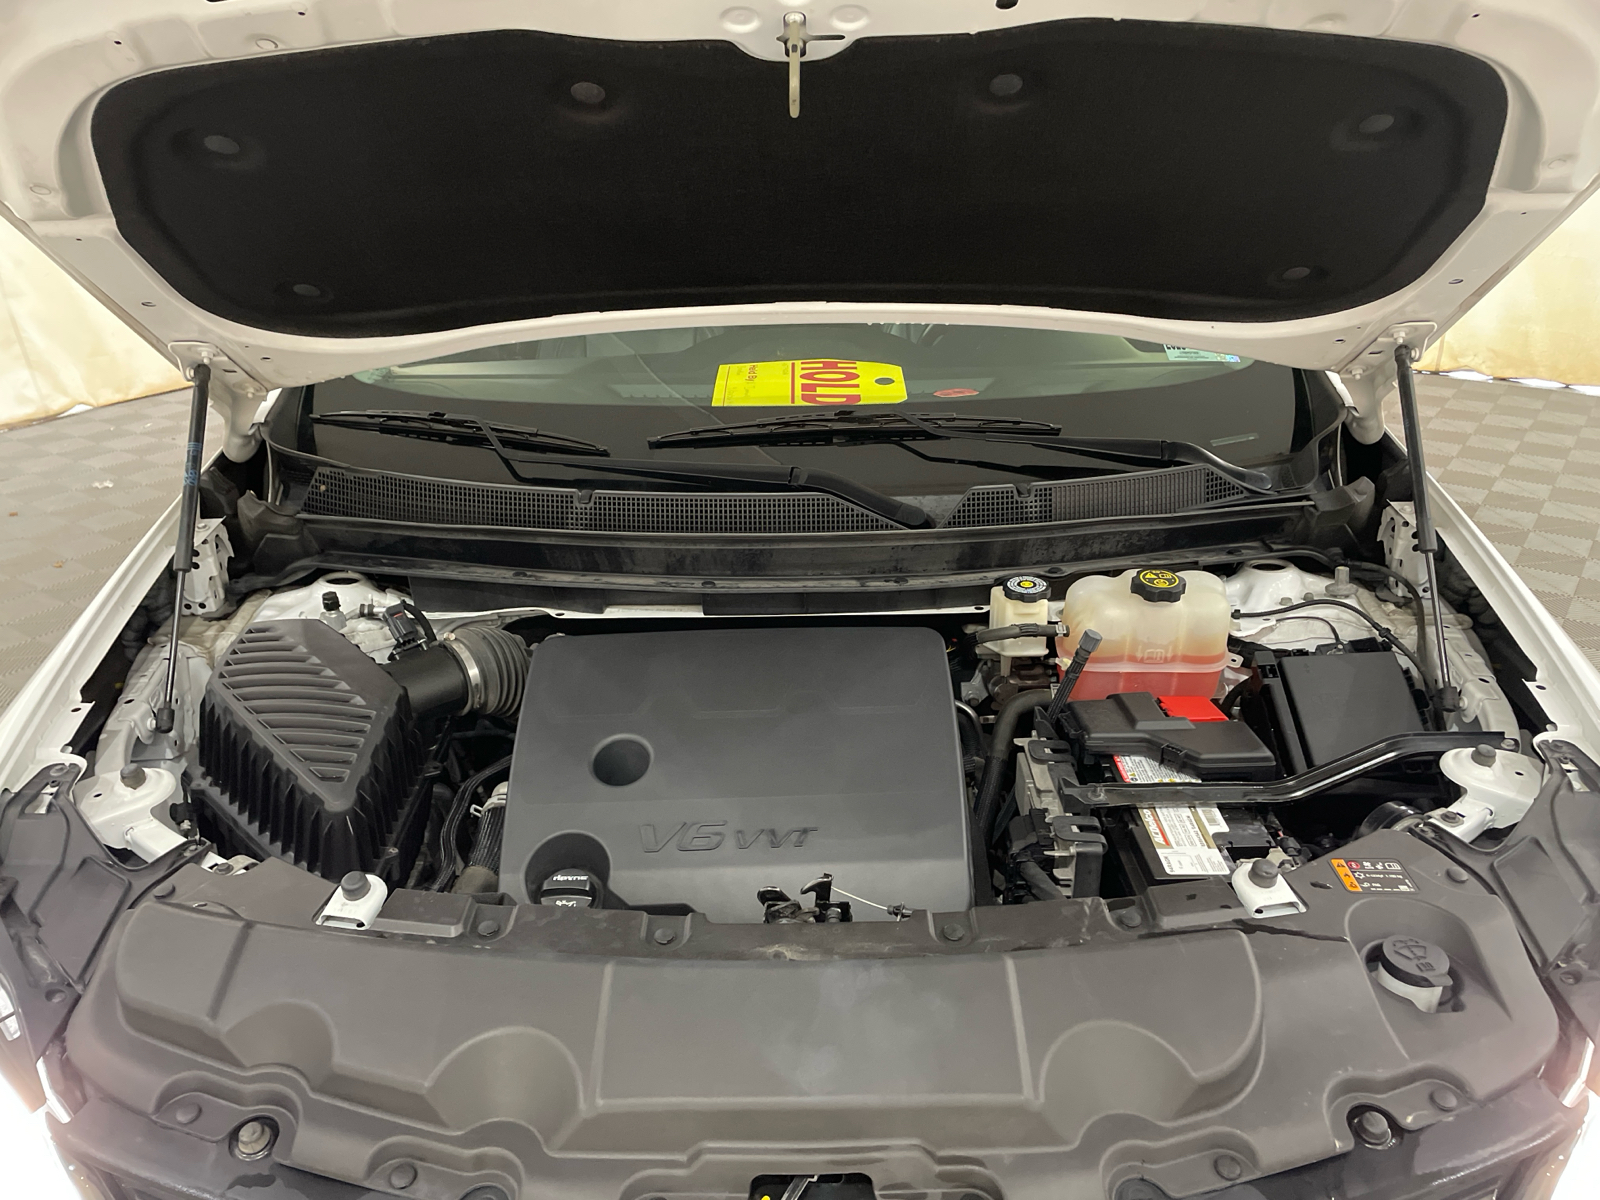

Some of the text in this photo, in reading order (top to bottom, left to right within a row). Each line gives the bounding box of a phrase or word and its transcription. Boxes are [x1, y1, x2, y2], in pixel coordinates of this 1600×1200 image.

[800, 360, 861, 405] HOLD
[639, 819, 819, 853] V6 VVT
[1142, 808, 1166, 845] ACDelco
